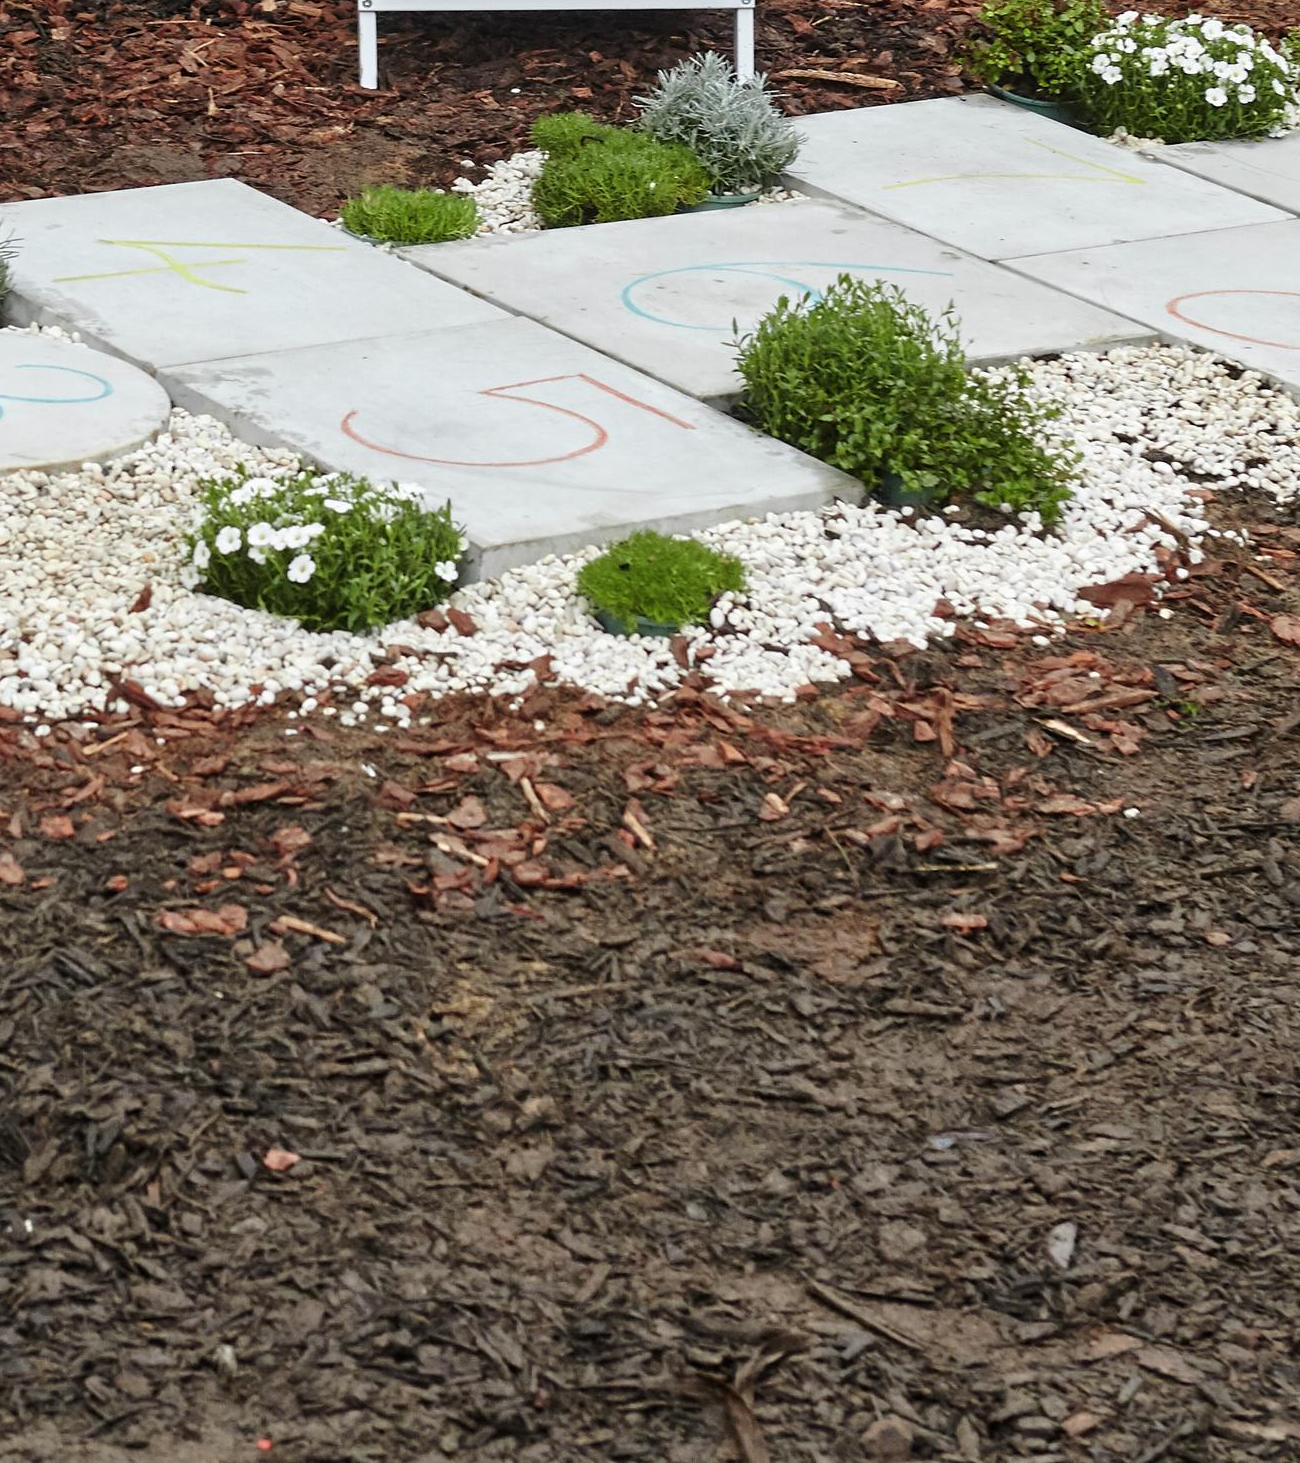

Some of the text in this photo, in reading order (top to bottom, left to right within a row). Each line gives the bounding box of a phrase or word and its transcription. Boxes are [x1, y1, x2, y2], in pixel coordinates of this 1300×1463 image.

[881, 136, 1149, 191] 7
[50, 236, 349, 295] 4
[621, 261, 955, 331] 6
[339, 372, 697, 468] 5
